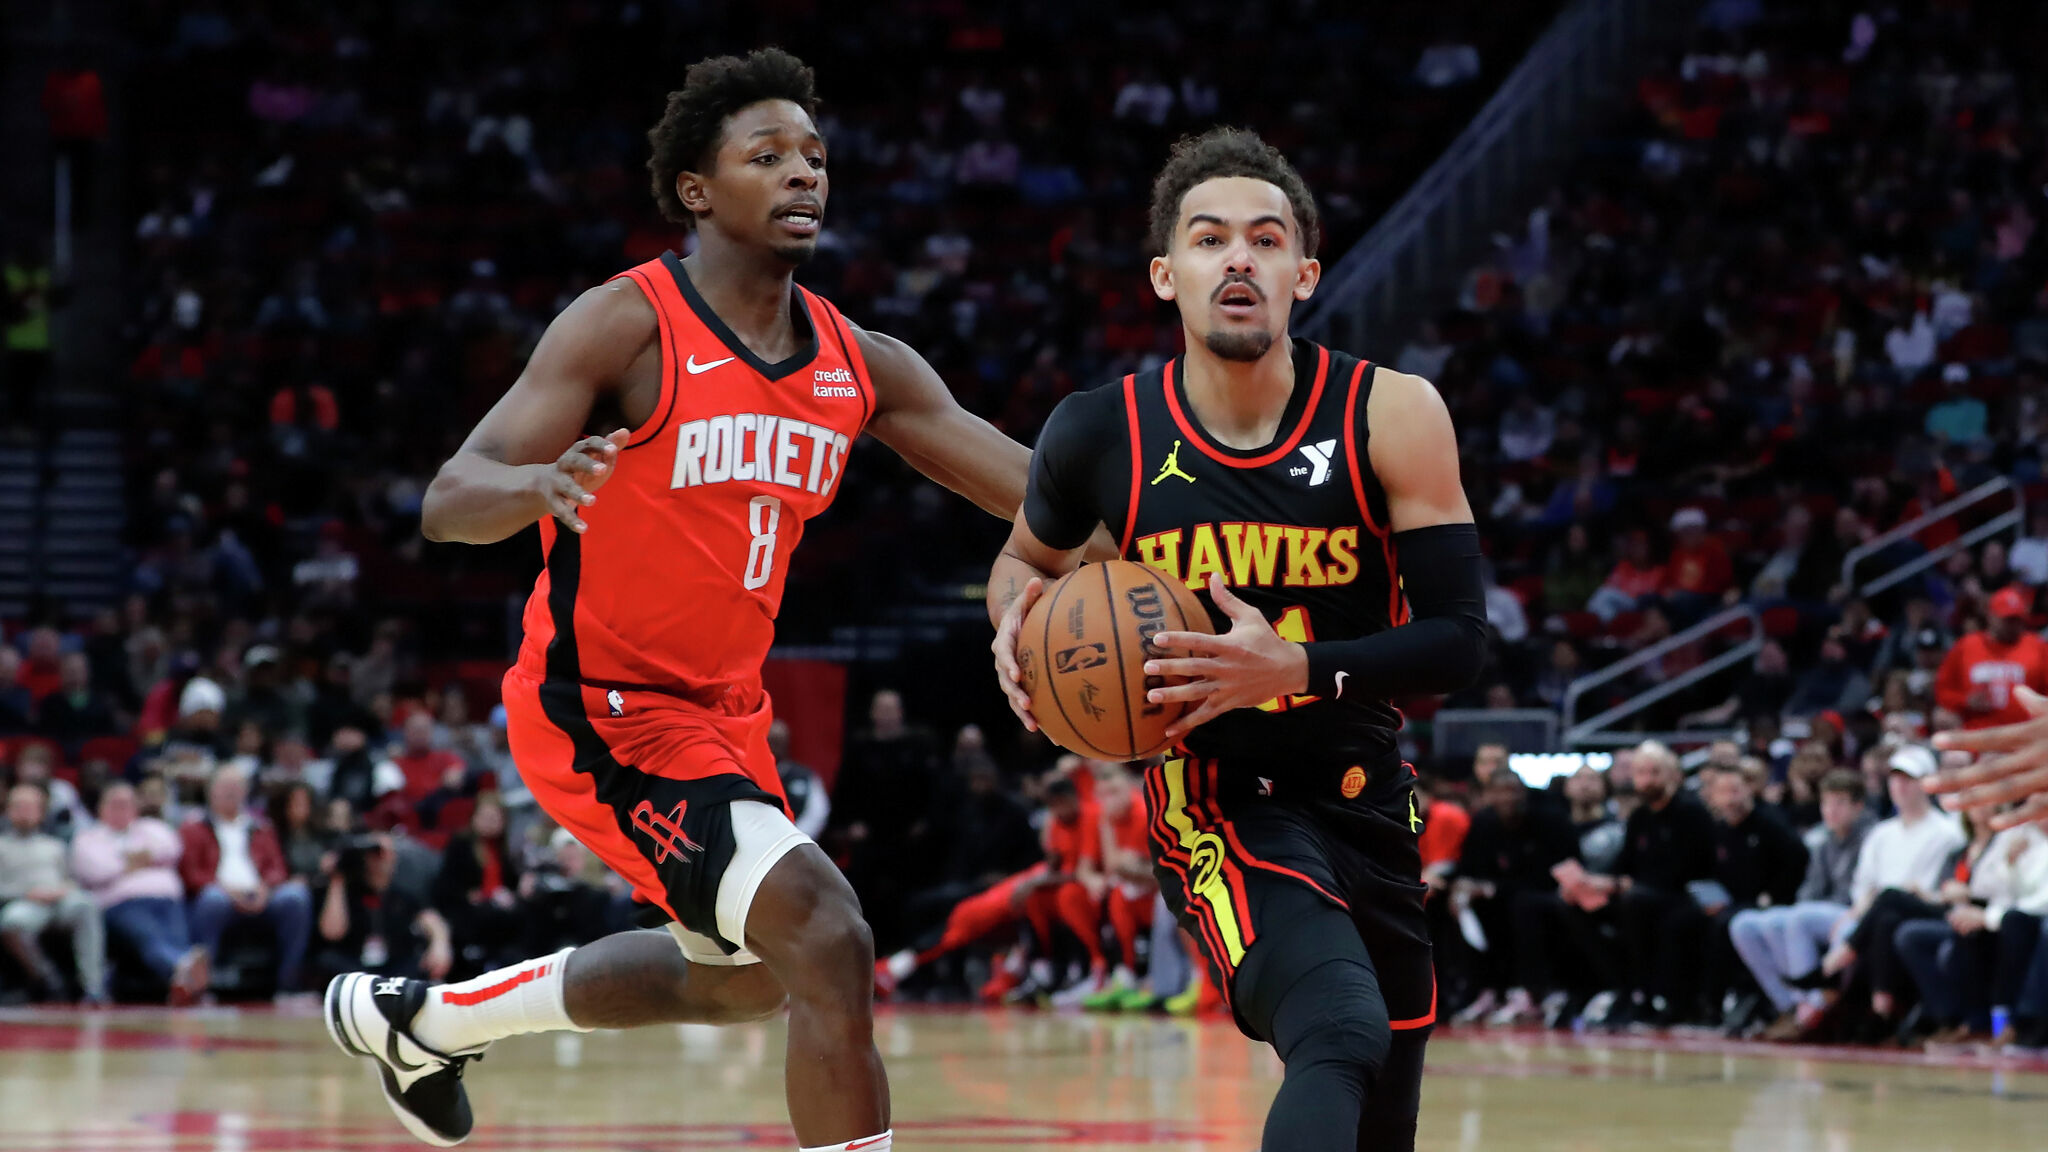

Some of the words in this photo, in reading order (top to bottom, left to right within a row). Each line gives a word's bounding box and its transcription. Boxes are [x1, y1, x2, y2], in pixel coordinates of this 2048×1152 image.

[813, 382, 857, 397] karma
[814, 368, 852, 383] credit
[669, 412, 850, 497] ROCKETS
[1289, 466, 1308, 477] the
[743, 494, 781, 591] 8
[1135, 521, 1360, 593] HAWKS
